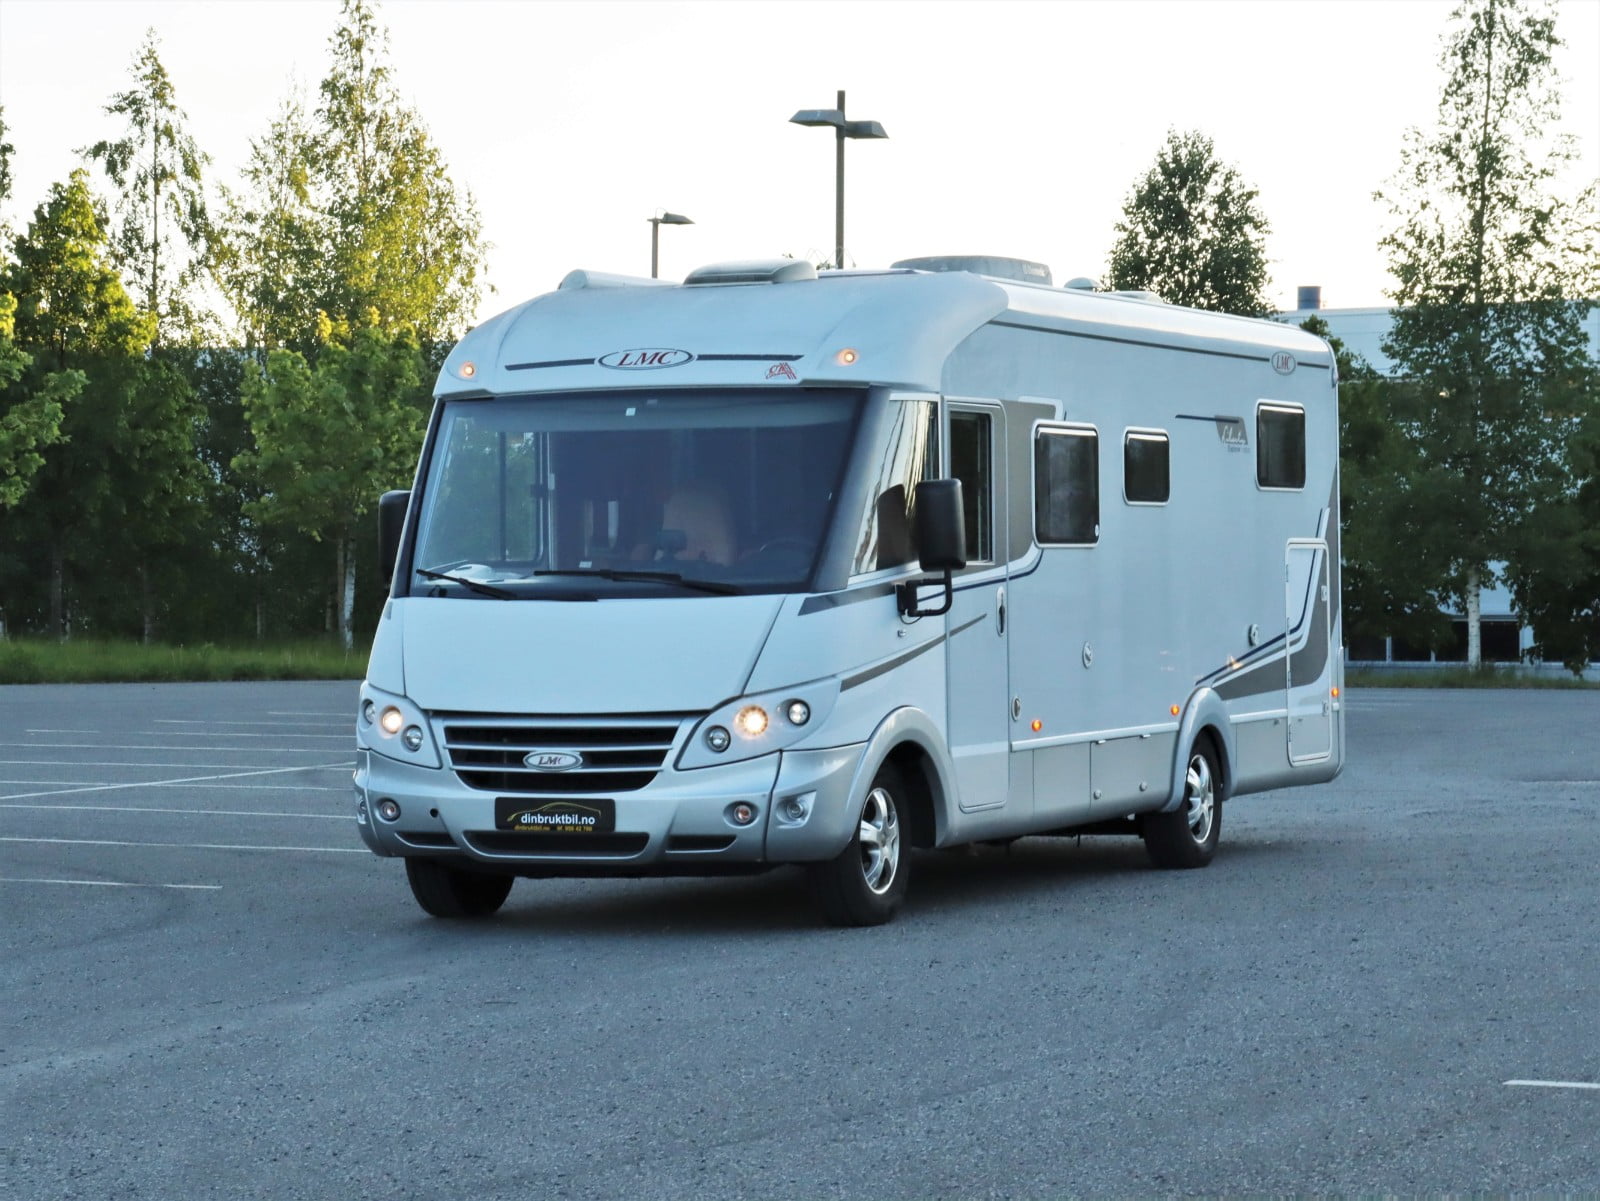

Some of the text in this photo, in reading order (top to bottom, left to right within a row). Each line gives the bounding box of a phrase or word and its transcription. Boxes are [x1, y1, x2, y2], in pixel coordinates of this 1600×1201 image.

[617, 351, 678, 367] LMC
[1276, 355, 1291, 371] LMC
[521, 814, 596, 825] dinbruktbil.no
